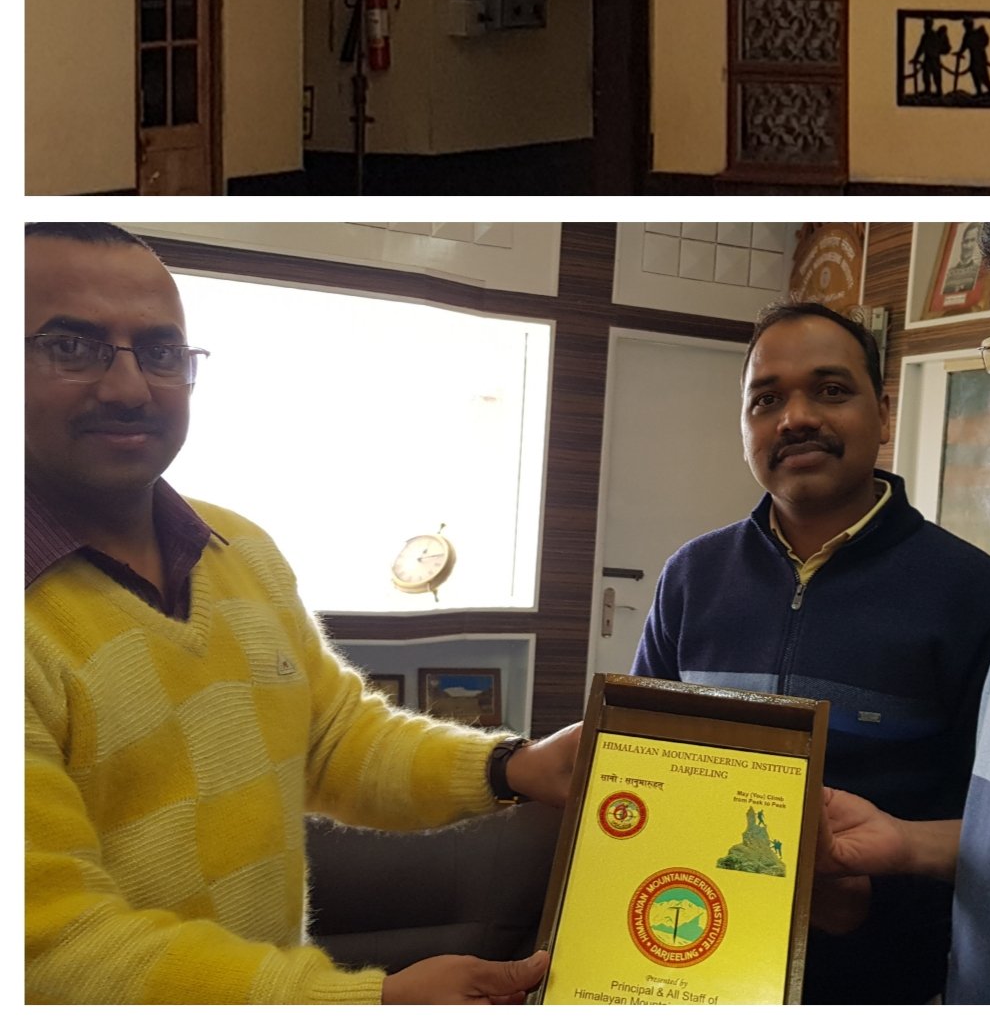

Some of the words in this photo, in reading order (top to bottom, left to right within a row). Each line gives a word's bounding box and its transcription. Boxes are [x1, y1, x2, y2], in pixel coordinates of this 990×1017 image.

[602, 741, 659, 756] HIMALAYAN
[662, 749, 749, 769] MOUNTAINEERING
[751, 761, 802, 776] INSTITUTE
[670, 764, 728, 779] DARJEELING
[634, 893, 649, 943] HIMALAYAN
[646, 873, 717, 900] MOUNTAINEERING
[701, 902, 722, 950] INSTITUTE
[650, 945, 699, 962] DARJEELING
[645, 974, 678, 986] Presented
[679, 977, 688, 989] by
[574, 988, 627, 1005] Himalayan
[610, 980, 654, 996] Principal
[657, 988, 664, 997] &
[666, 989, 680, 1000] All
[682, 991, 706, 1004] Staff
[708, 995, 719, 1005] of
